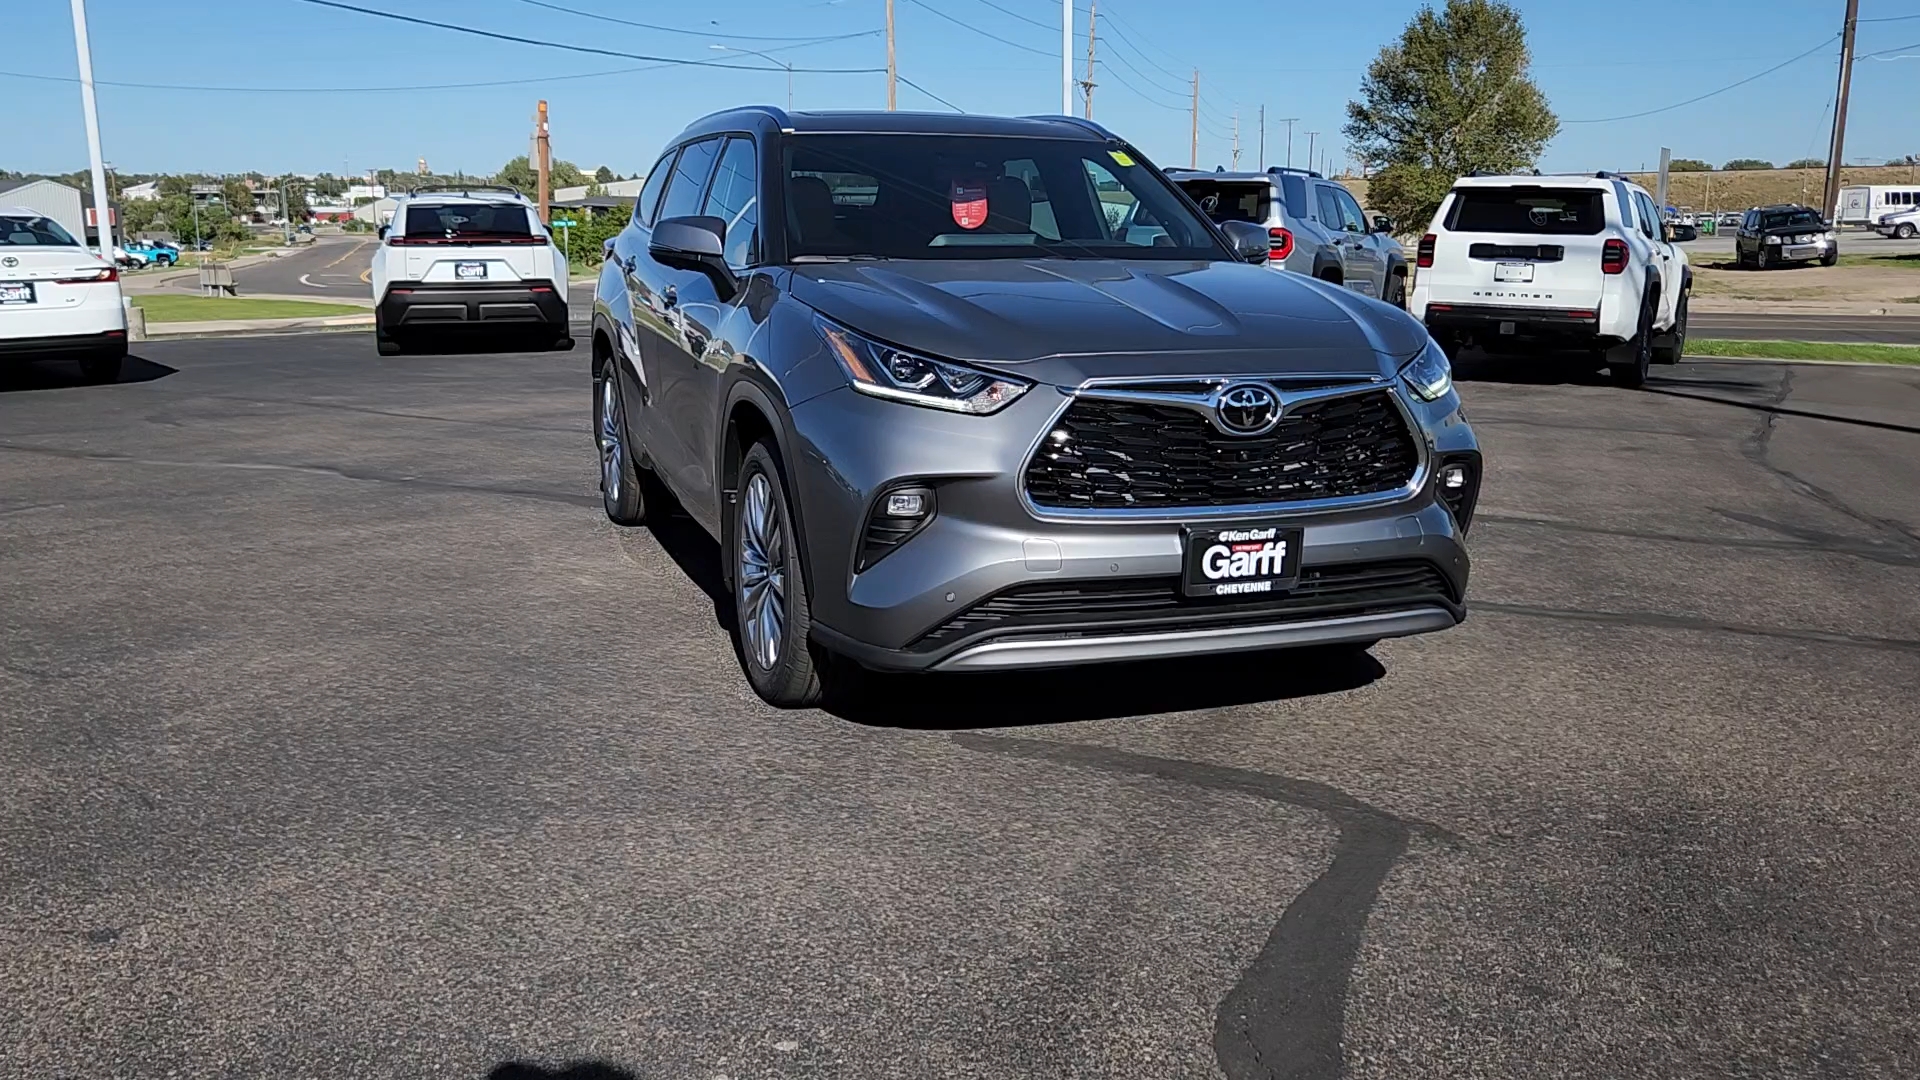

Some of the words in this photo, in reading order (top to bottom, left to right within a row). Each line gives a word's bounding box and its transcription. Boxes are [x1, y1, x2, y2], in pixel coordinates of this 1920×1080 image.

[1229, 530, 1250, 542] Ken
[1249, 528, 1277, 541] Garff
[1202, 541, 1287, 580] Garff
[1216, 581, 1272, 595] CHEYENNE
